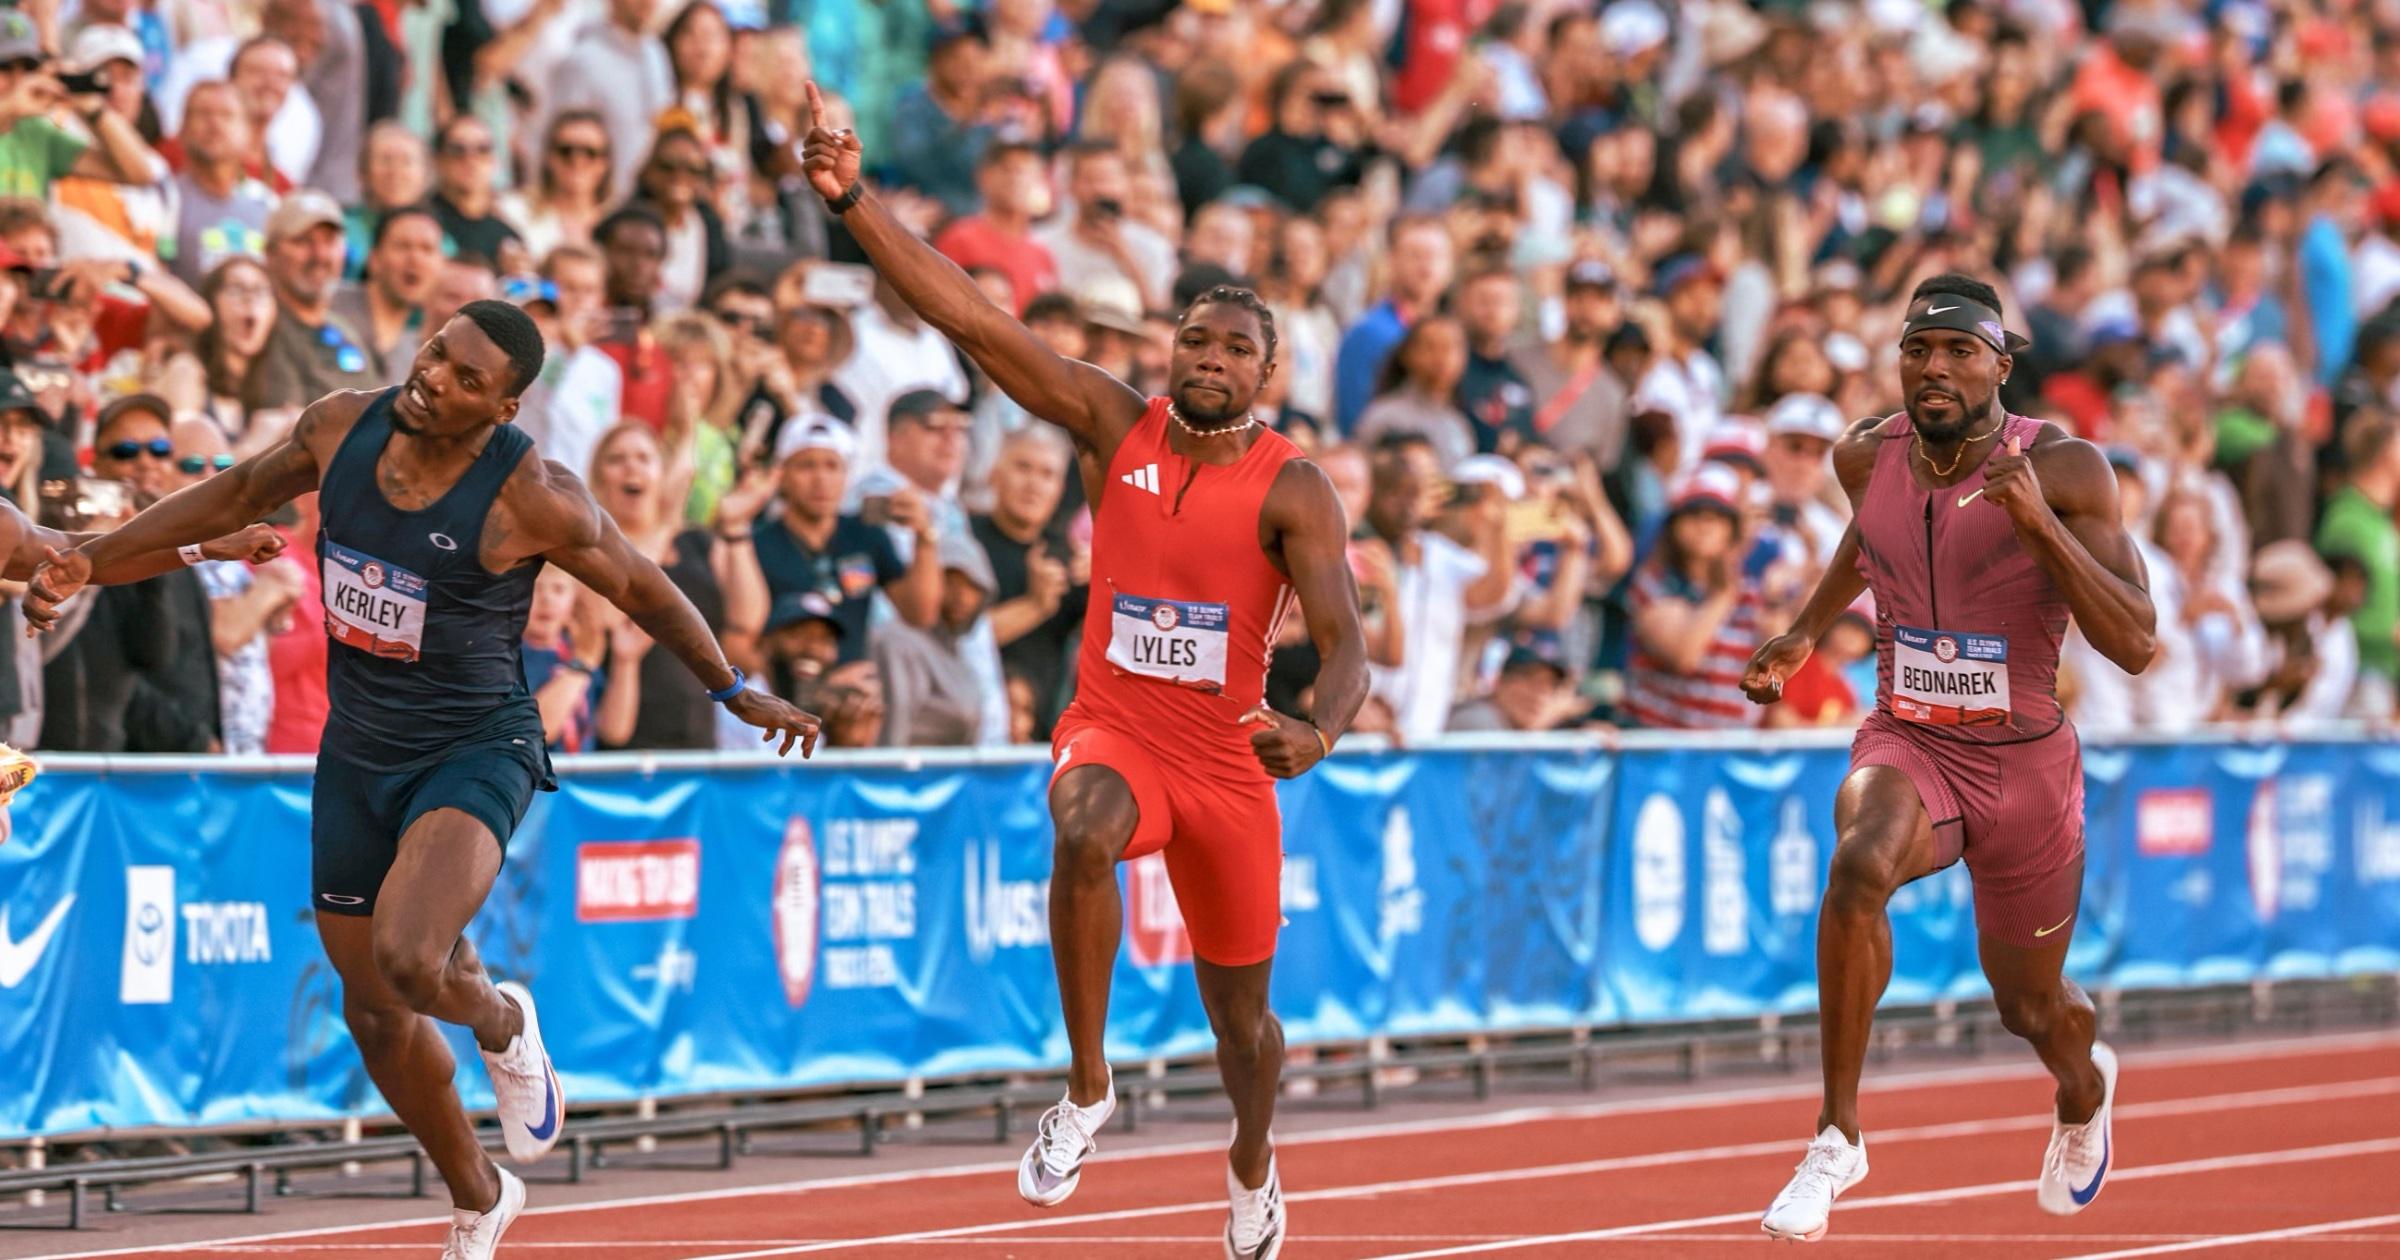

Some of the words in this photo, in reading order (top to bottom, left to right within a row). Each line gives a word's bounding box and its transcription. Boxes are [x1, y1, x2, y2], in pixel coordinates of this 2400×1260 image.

[335, 581, 406, 629] KERLEY
[1134, 634, 1197, 666] LYLES
[1904, 666, 1996, 695] BEDNAREK
[181, 901, 272, 964] TOYOTA
